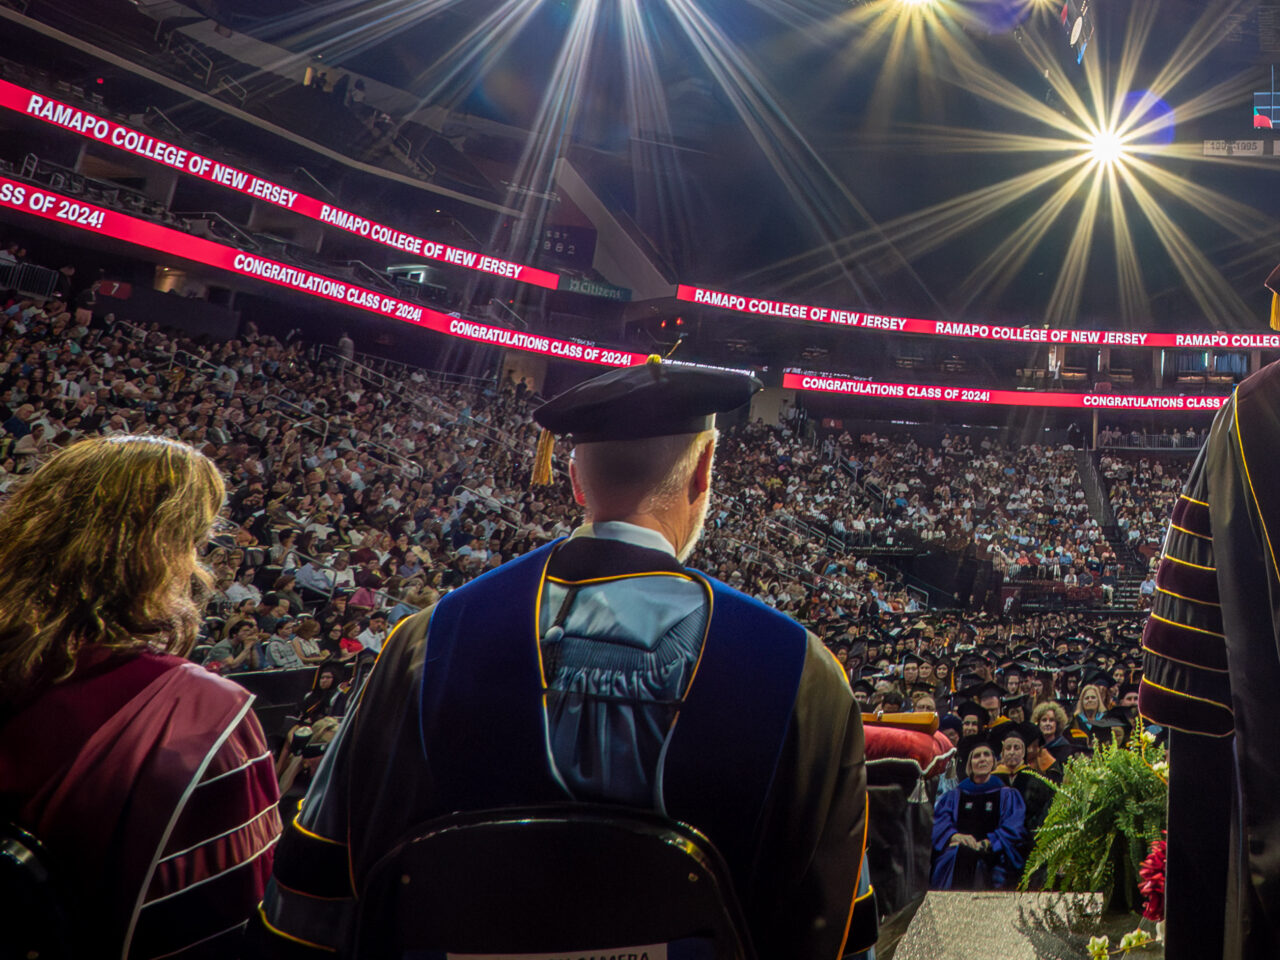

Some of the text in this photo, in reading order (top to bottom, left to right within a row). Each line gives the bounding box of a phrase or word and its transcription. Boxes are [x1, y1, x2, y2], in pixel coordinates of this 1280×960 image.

[26, 94, 298, 208] RAMAPO COLLEGE OF NEW JERSEY
[29, 192, 56, 213] OF
[56, 200, 105, 229] 2024!
[319, 204, 523, 279] RAMAPO COLLEGE OF NEW JERSEY
[112, 283, 119, 296] 7
[233, 254, 423, 322] CONGRATULATIONS CLASS OF 2024!
[694, 289, 907, 331] RAMAPO COLLEGE OF NEW JERSEY
[449, 320, 550, 352] CONGRATULATIONS
[550, 341, 583, 358] CLASS
[583, 348, 600, 361] OF
[600, 352, 632, 366] 2024!
[935, 322, 1147, 345] RAMAPO COLLEGE OF NEW JERSEY
[1176, 334, 1228, 346] RAMAPO
[802, 377, 990, 401] CONGRATULATIONS CLASS OF 2024!
[1083, 396, 1184, 408] CONGRATULATIONS
[1186, 398, 1220, 408] CLASS
